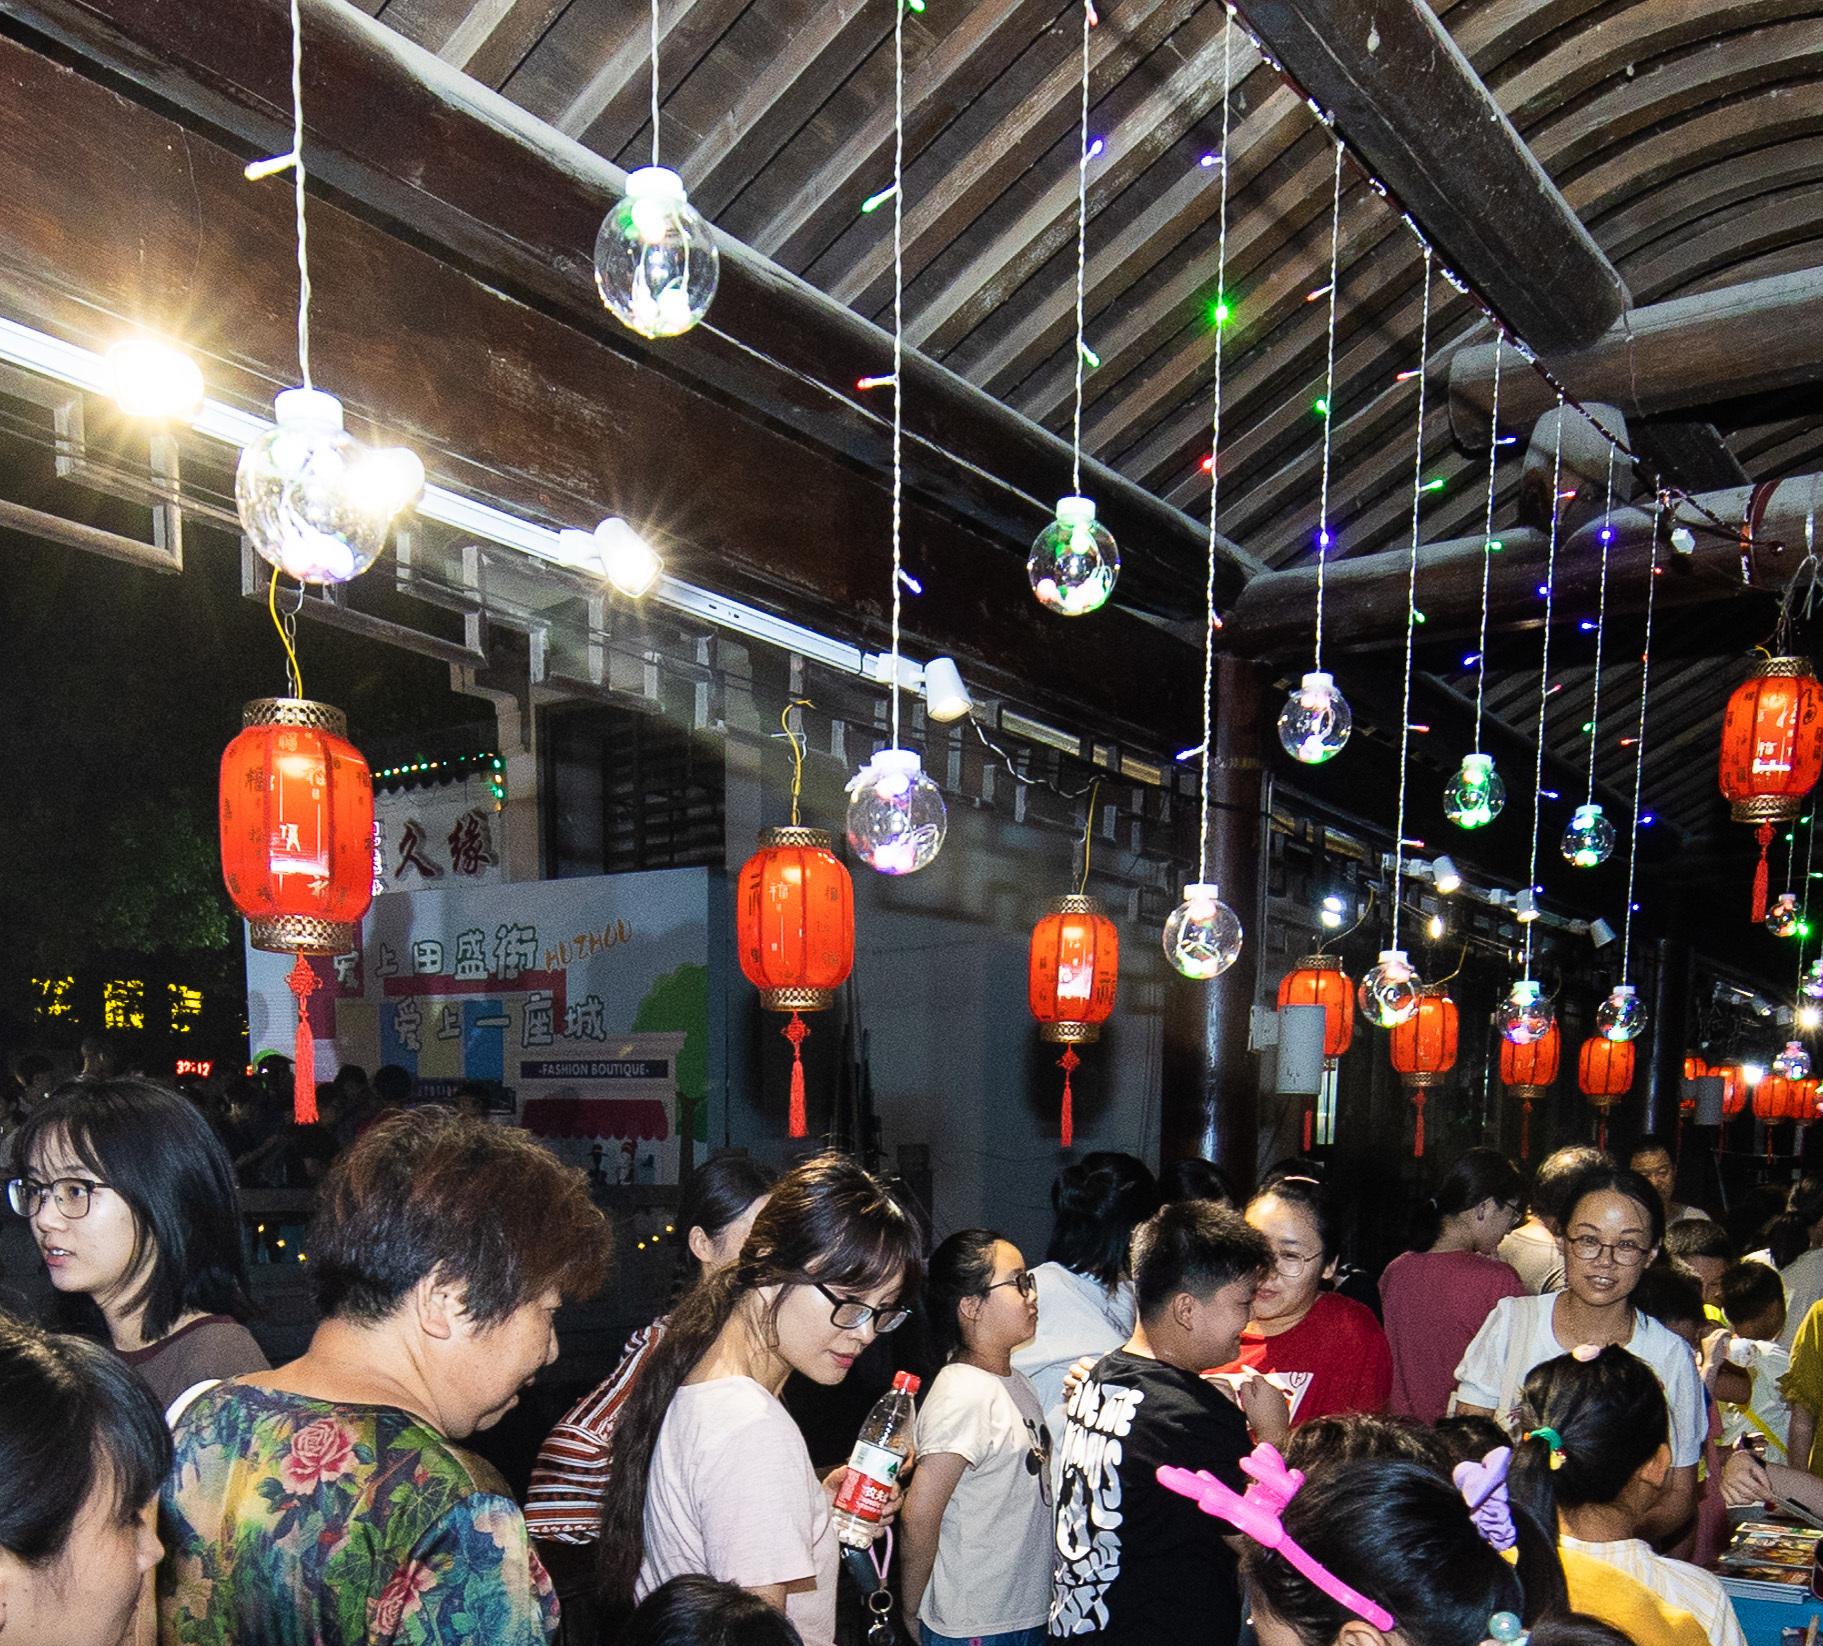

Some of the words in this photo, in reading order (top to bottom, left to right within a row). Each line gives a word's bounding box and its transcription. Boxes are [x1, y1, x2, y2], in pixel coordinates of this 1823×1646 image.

[393, 992, 607, 1051] 爱上一座城
